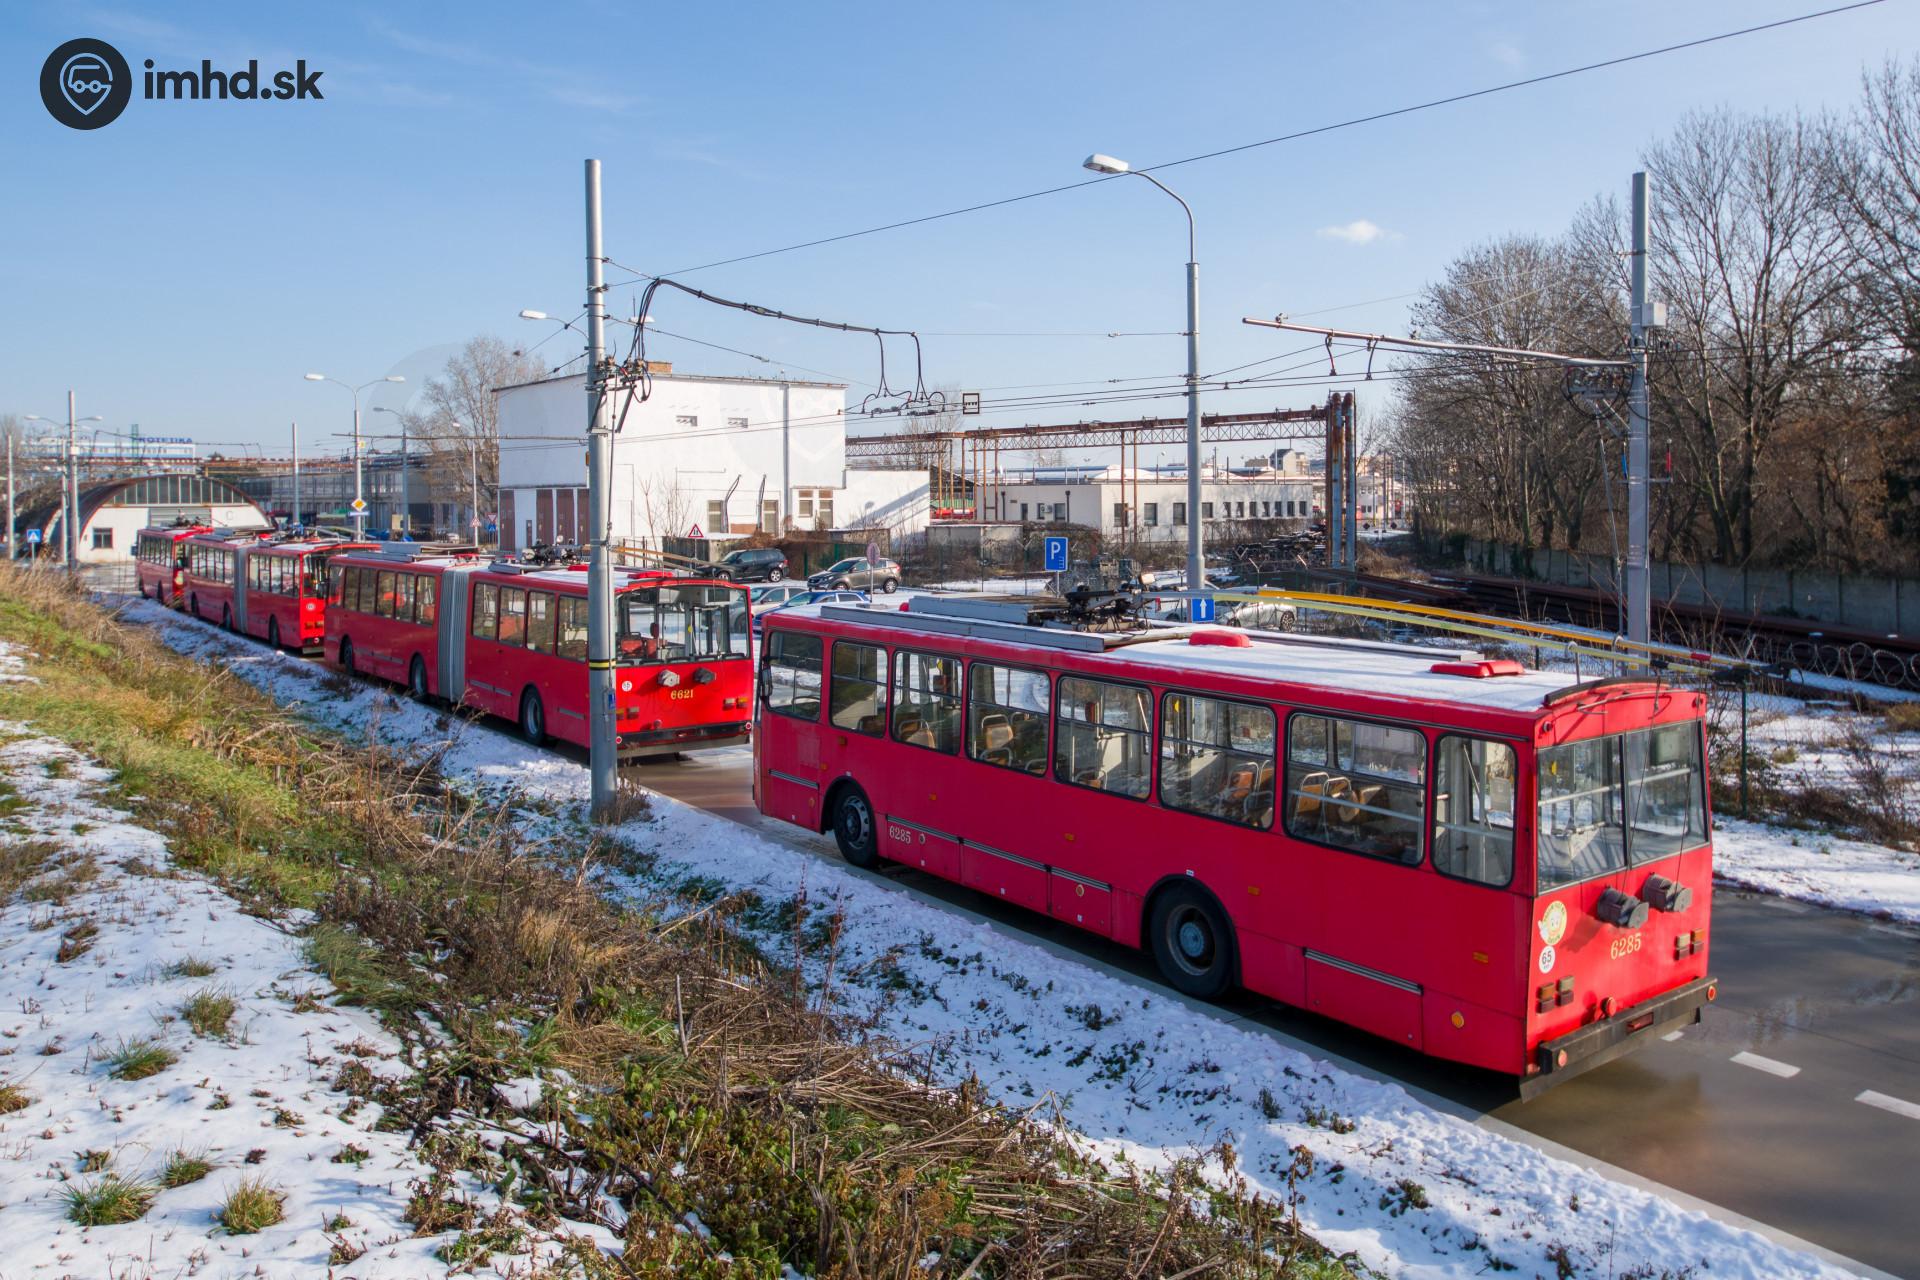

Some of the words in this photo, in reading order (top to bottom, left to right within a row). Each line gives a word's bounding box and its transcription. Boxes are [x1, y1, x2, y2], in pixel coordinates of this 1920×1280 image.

[1051, 541, 1061, 560] P
[670, 689, 694, 700] 6621
[888, 825, 911, 844] 6285
[1611, 932, 1642, 960] 6285
[1542, 950, 1552, 965] 65
